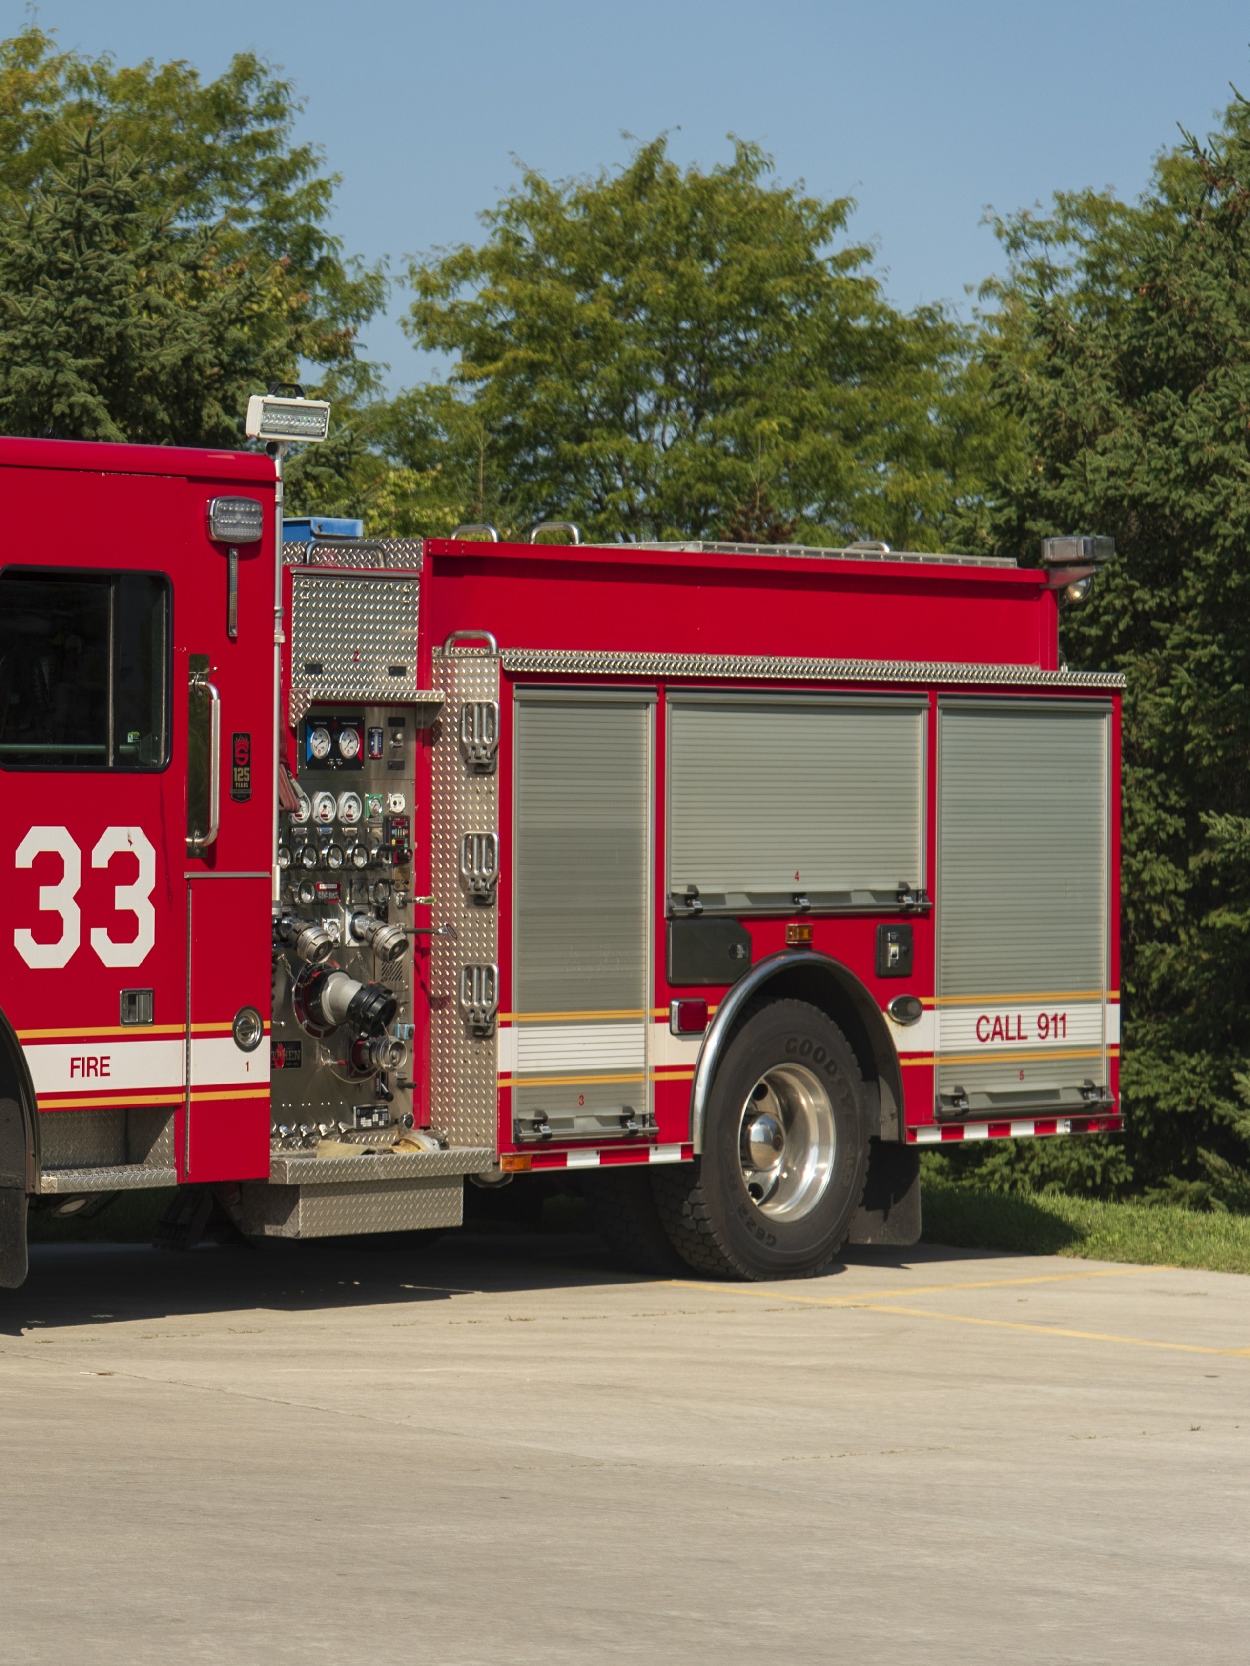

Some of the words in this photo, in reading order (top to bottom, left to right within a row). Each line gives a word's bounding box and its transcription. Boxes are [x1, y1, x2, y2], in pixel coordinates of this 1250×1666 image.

[353, 650, 359, 662] 2
[233, 767, 250, 782] 125
[14, 826, 156, 970] 33
[976, 1014, 1028, 1042] CALL
[1037, 1012, 1067, 1039] 911
[70, 1055, 111, 1078] FIRE
[245, 1061, 250, 1072] 1
[1019, 1069, 1025, 1081] 5
[578, 1095, 584, 1106] 3
[737, 1203, 778, 1248] G622
